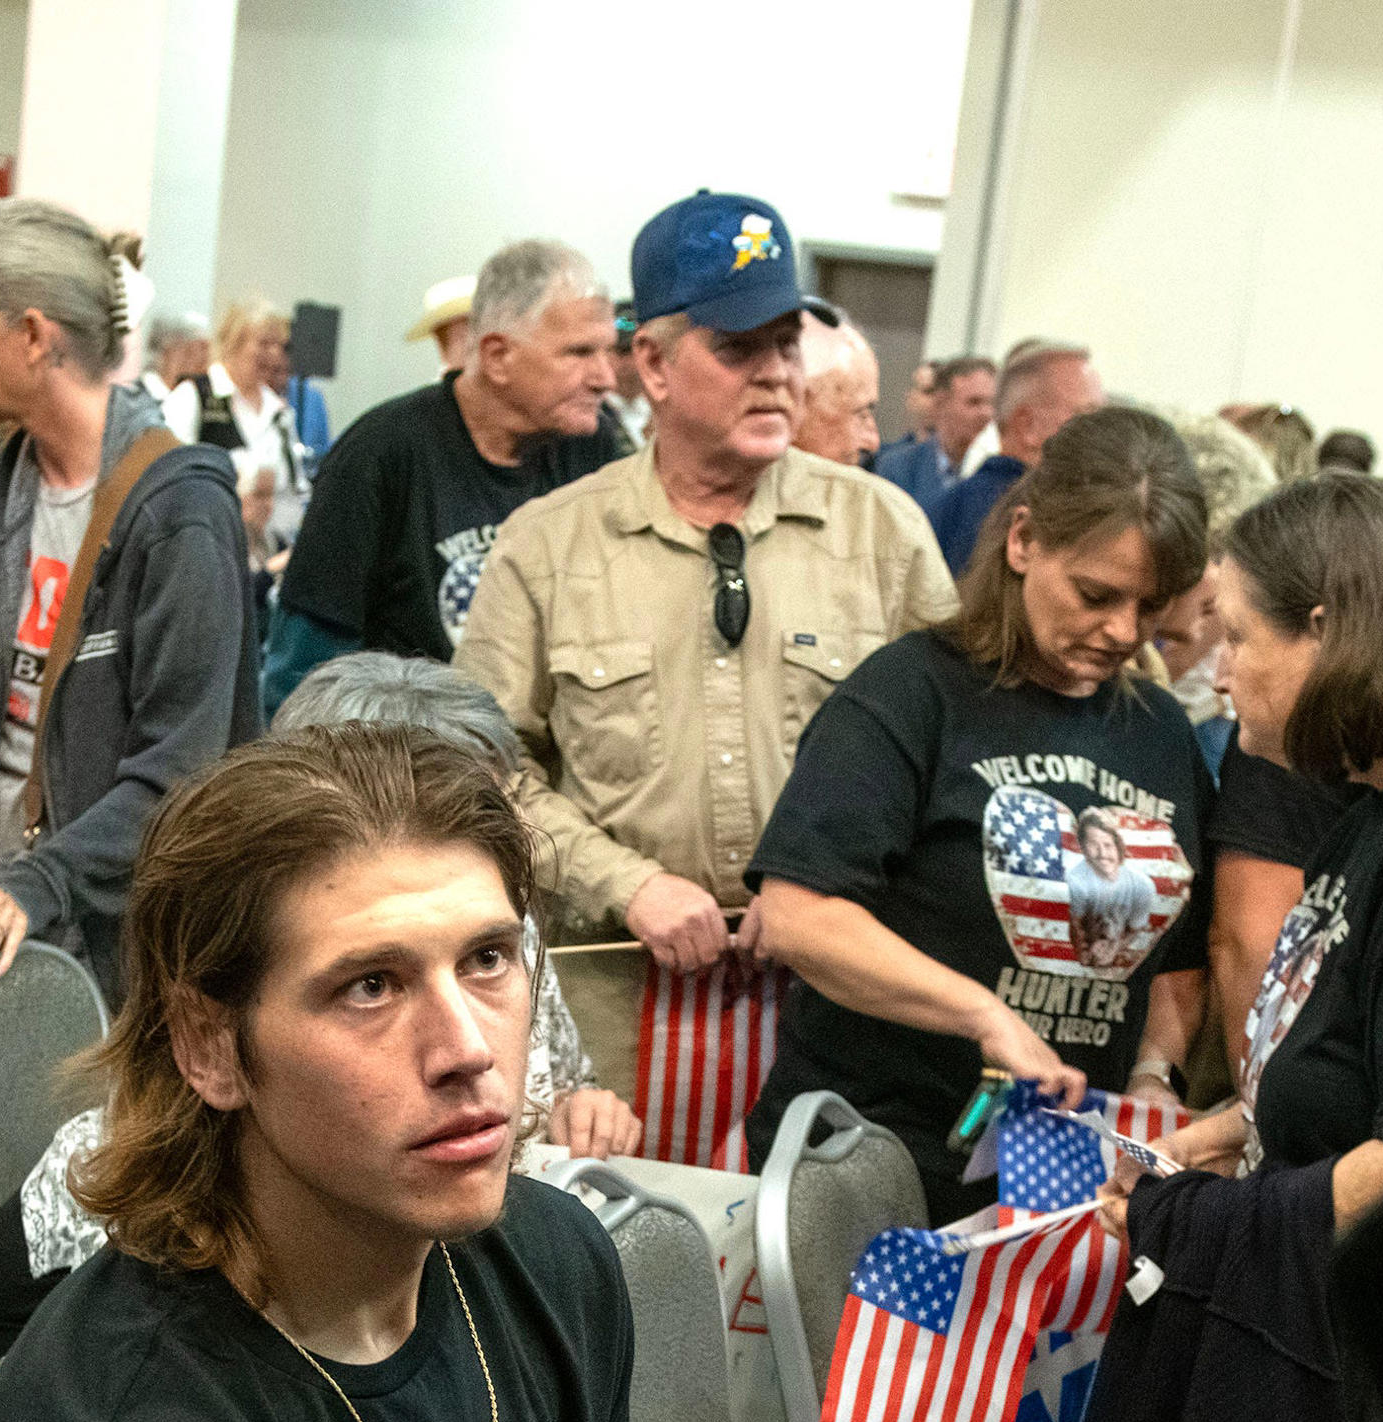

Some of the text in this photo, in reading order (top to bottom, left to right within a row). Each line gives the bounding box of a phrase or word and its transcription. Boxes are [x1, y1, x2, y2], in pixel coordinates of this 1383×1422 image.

[971, 753, 1176, 825] WELCOME HOME
[996, 966, 1130, 1023] HUNTER
[1054, 1016, 1112, 1047] HERO
